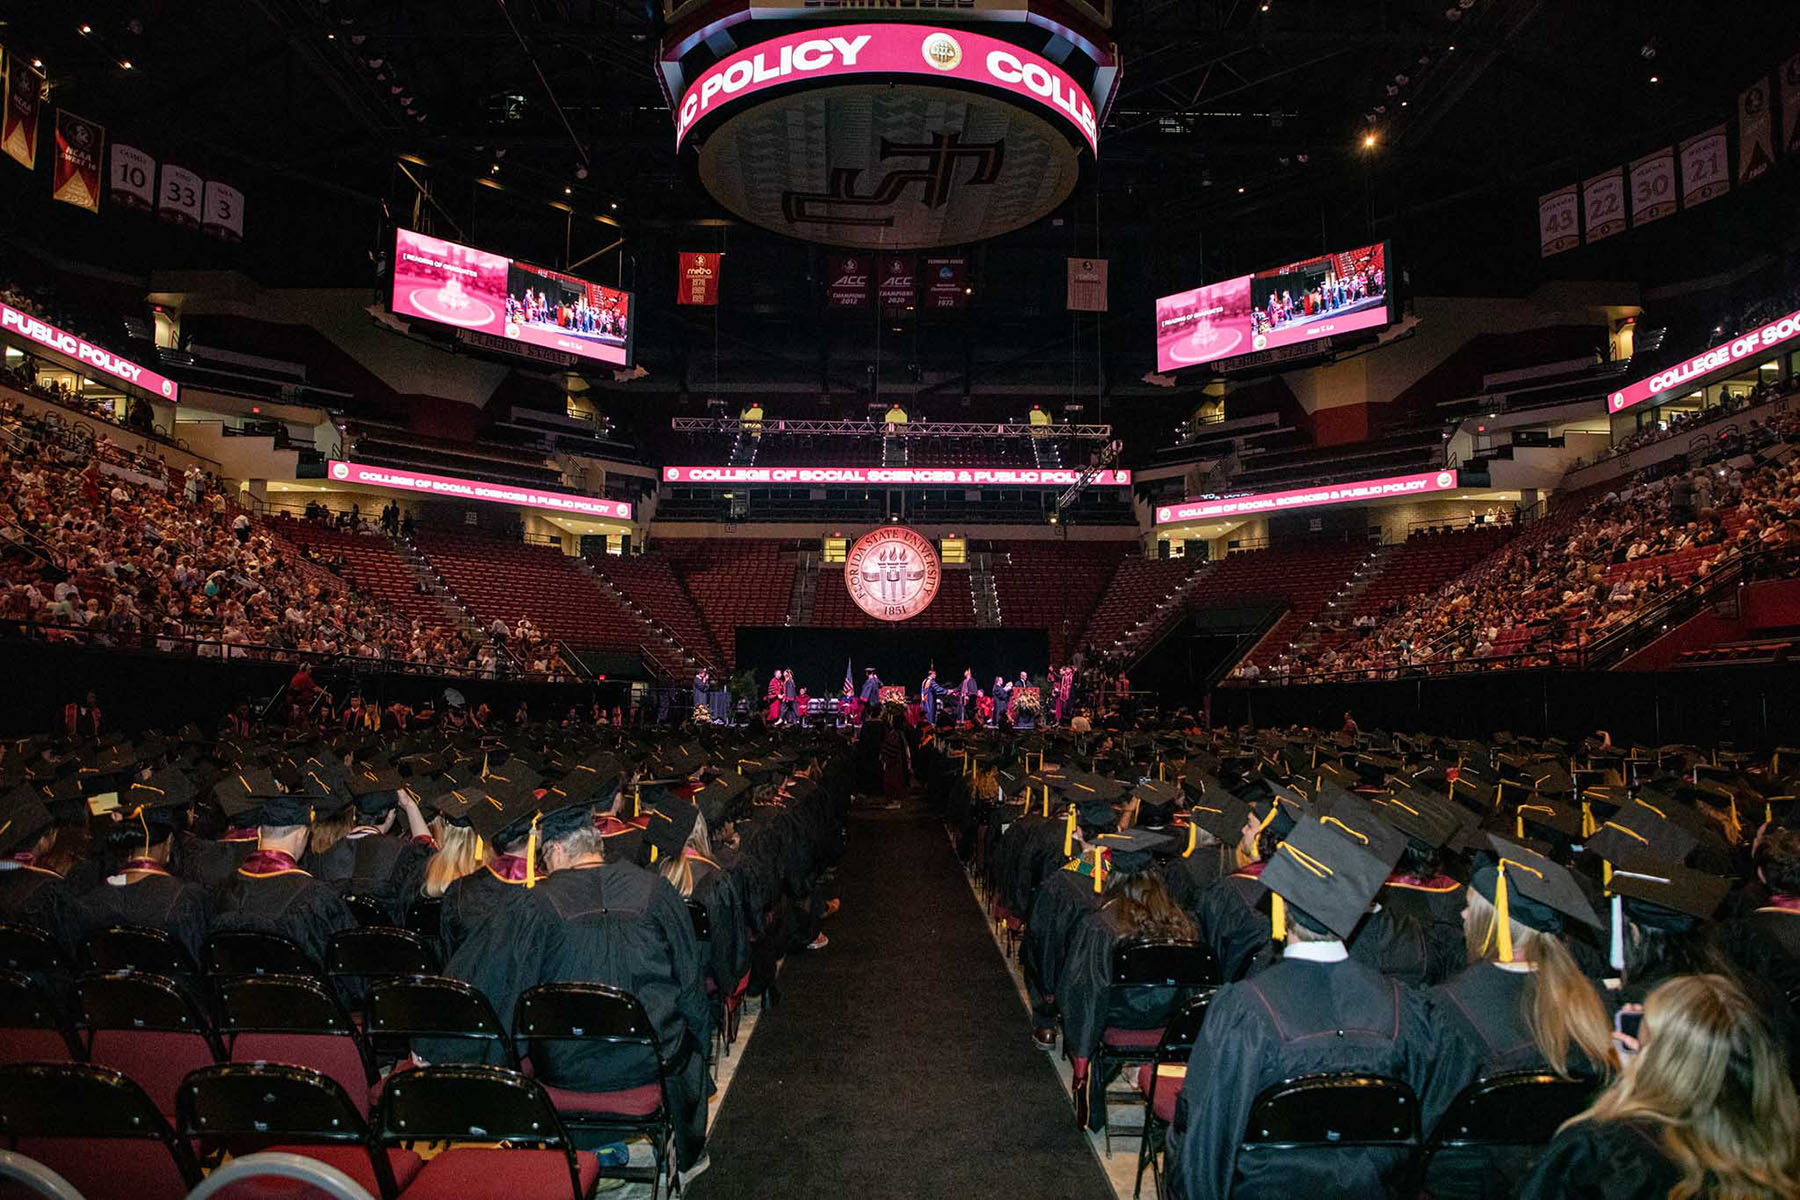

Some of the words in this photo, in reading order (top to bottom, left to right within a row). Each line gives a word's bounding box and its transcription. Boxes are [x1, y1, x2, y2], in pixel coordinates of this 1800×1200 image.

[701, 35, 872, 110] POLICY
[120, 164, 145, 188] 10
[1690, 153, 1717, 182] 21
[167, 182, 195, 207] 33
[1637, 174, 1669, 202] 30
[218, 200, 231, 220] 3
[1590, 193, 1619, 220] 22
[1546, 209, 1574, 233] 43
[687, 267, 713, 275] metro
[834, 275, 868, 285] ACC
[882, 276, 913, 285] ACC
[2, 307, 77, 356] PUBLIC
[78, 342, 142, 382] POLICY
[1649, 346, 1730, 393] COLLEGE
[1731, 332, 1760, 358] OF
[689, 469, 770, 481] COLLEGE
[772, 469, 797, 481] OF
[799, 470, 866, 482] SOCIAL
[867, 470, 956, 482] SCIENCES
[957, 470, 972, 483] &
[974, 471, 1039, 483] PUBLIC
[1040, 472, 1105, 482] POLIY
[359, 471, 415, 487] COLLEGE
[414, 479, 432, 488] OF
[432, 481, 475, 495] SOCIAL
[474, 487, 528, 502] SCIENCES
[527, 495, 537, 504] &
[536, 496, 574, 509] PUBLIC
[573, 501, 610, 513] POLICY
[1178, 505, 1224, 518] COLLEGE
[1222, 503, 1238, 513] OF
[1236, 499, 1277, 511] SOCIAL
[1275, 492, 1331, 506] SCIENCES
[1329, 491, 1340, 500] &
[1340, 485, 1383, 499] PUBLIC
[1382, 479, 1427, 493] POLICY
[849, 548, 867, 600] FLORIDA
[865, 529, 900, 547] STATE
[903, 530, 938, 597] UNIVERSITY
[884, 605, 907, 616] 1851
